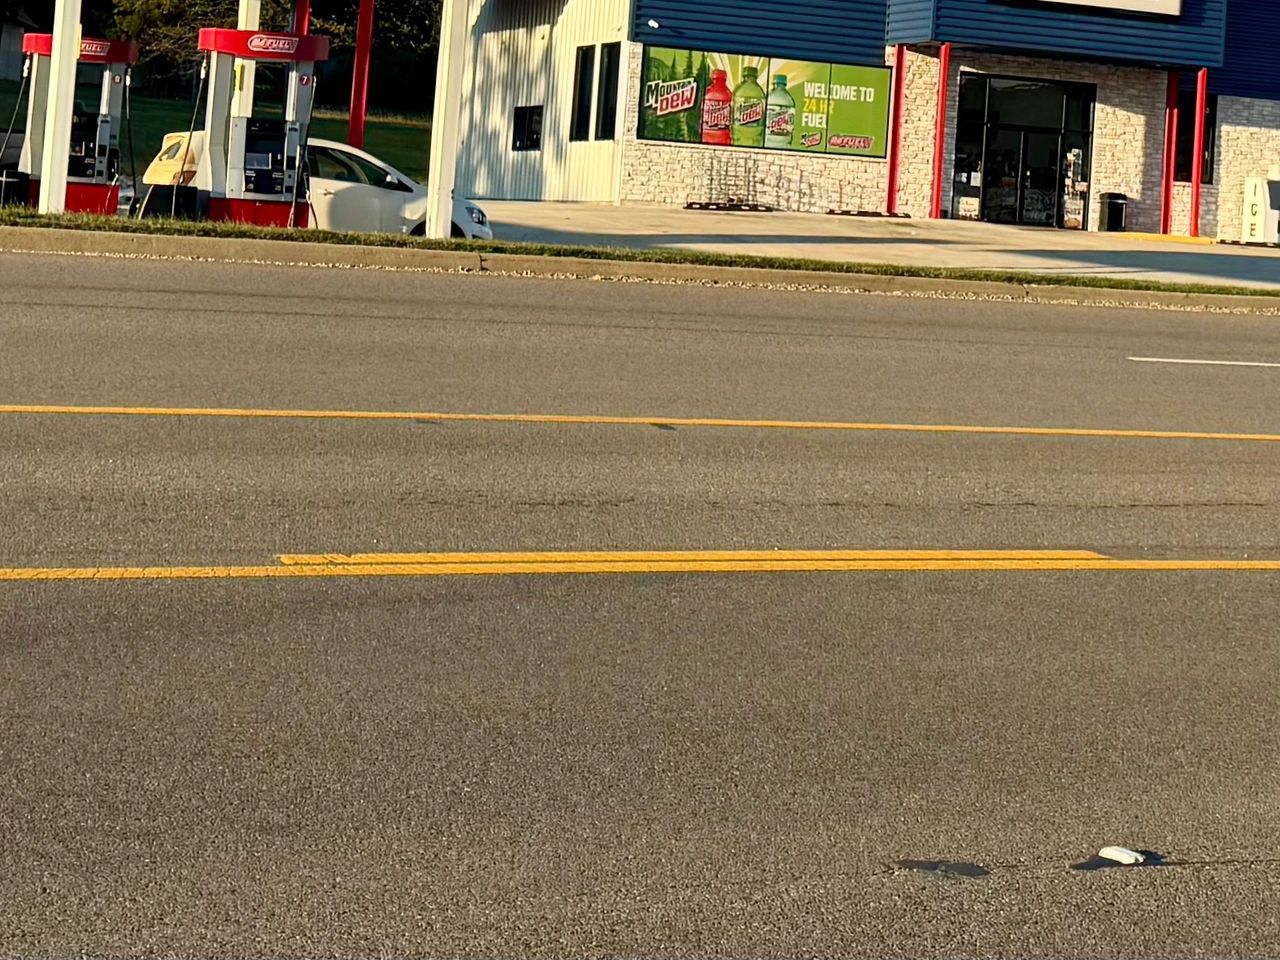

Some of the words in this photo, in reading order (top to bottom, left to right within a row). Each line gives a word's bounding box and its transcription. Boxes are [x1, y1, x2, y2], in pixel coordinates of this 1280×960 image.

[302, 75, 308, 84] 7
[859, 86, 875, 102] TO
[803, 99, 817, 112] 24
[801, 113, 827, 128] FUEL
[1250, 183, 1258, 237] ICE
